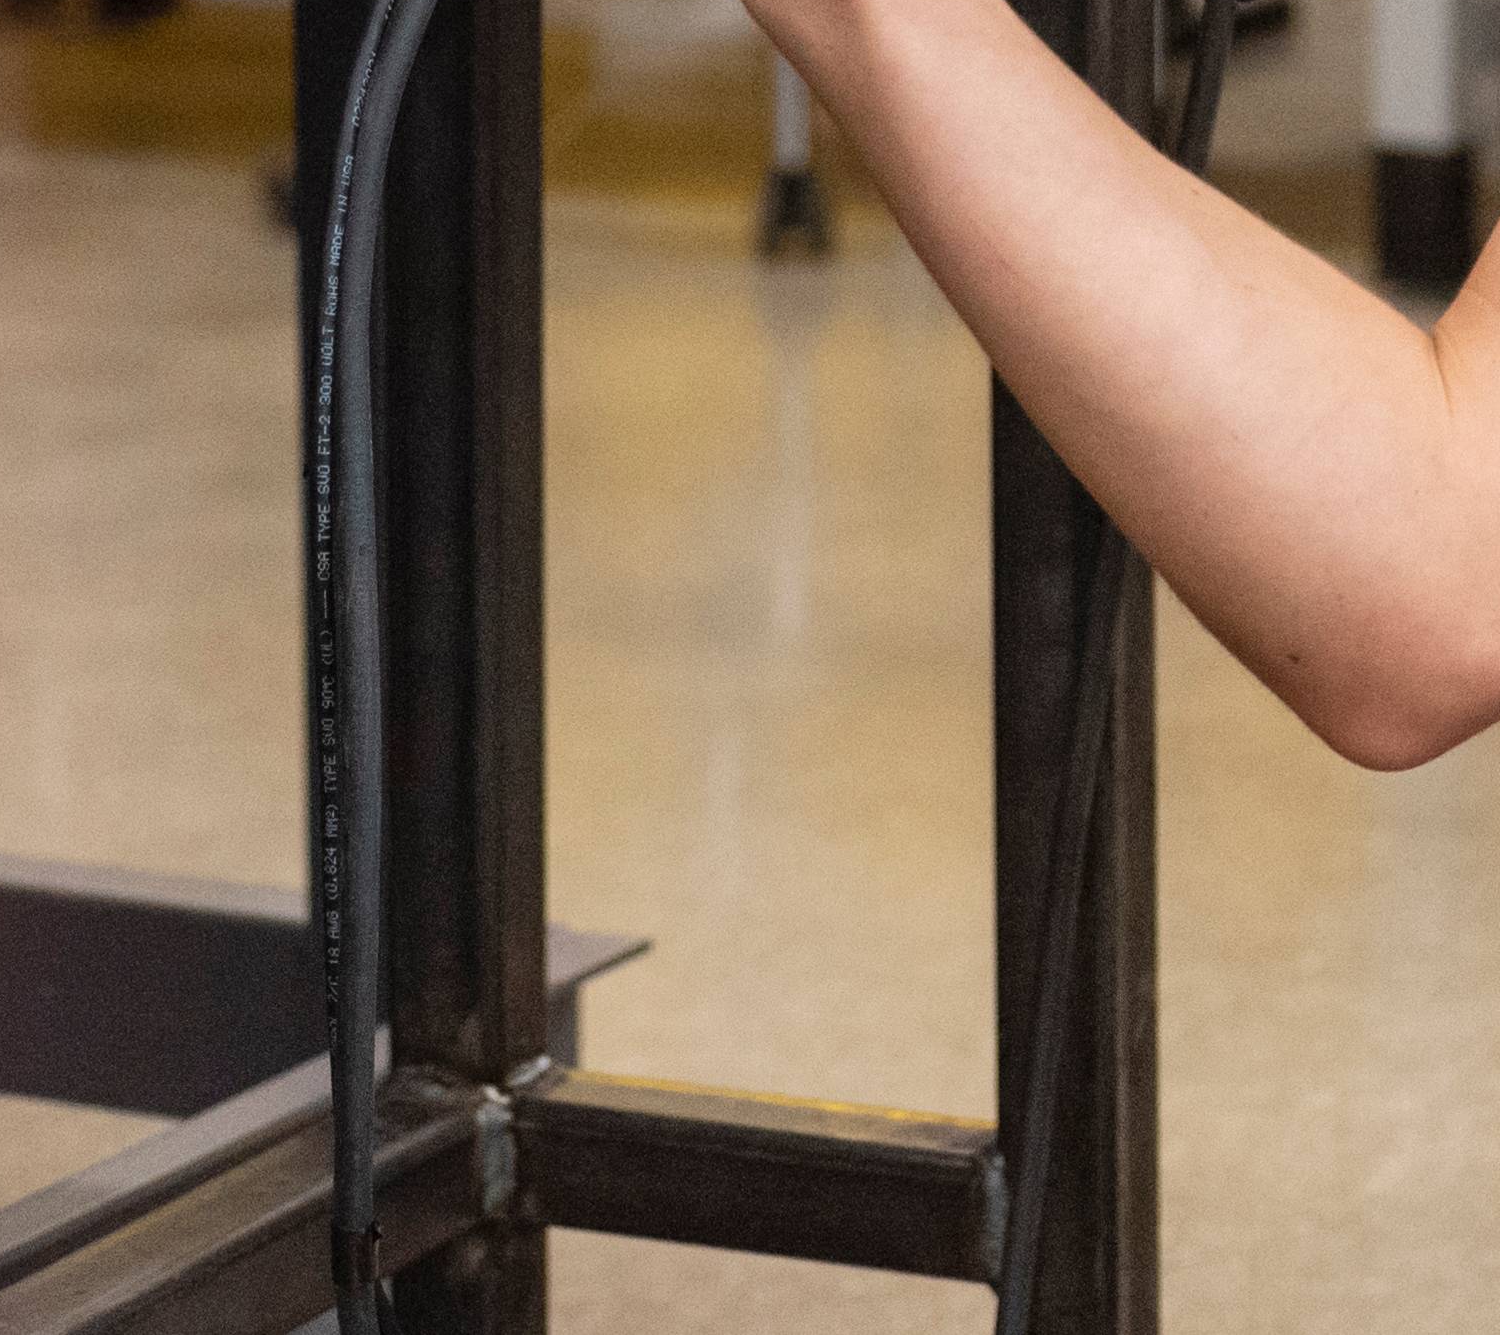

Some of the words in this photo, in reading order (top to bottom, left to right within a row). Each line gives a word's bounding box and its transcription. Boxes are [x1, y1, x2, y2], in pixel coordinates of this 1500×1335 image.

[342, 155, 354, 186] USA
[337, 194, 348, 213] IN
[330, 224, 345, 266] MADE
[320, 325, 335, 366] VOLT
[319, 375, 333, 406] 300
[318, 415, 331, 456] FT-2
[316, 503, 331, 542] TYPE
[317, 551, 331, 581] CSA
[323, 754, 338, 793] TYPE
[326, 910, 340, 939] AWG
[327, 947, 340, 964] 18
